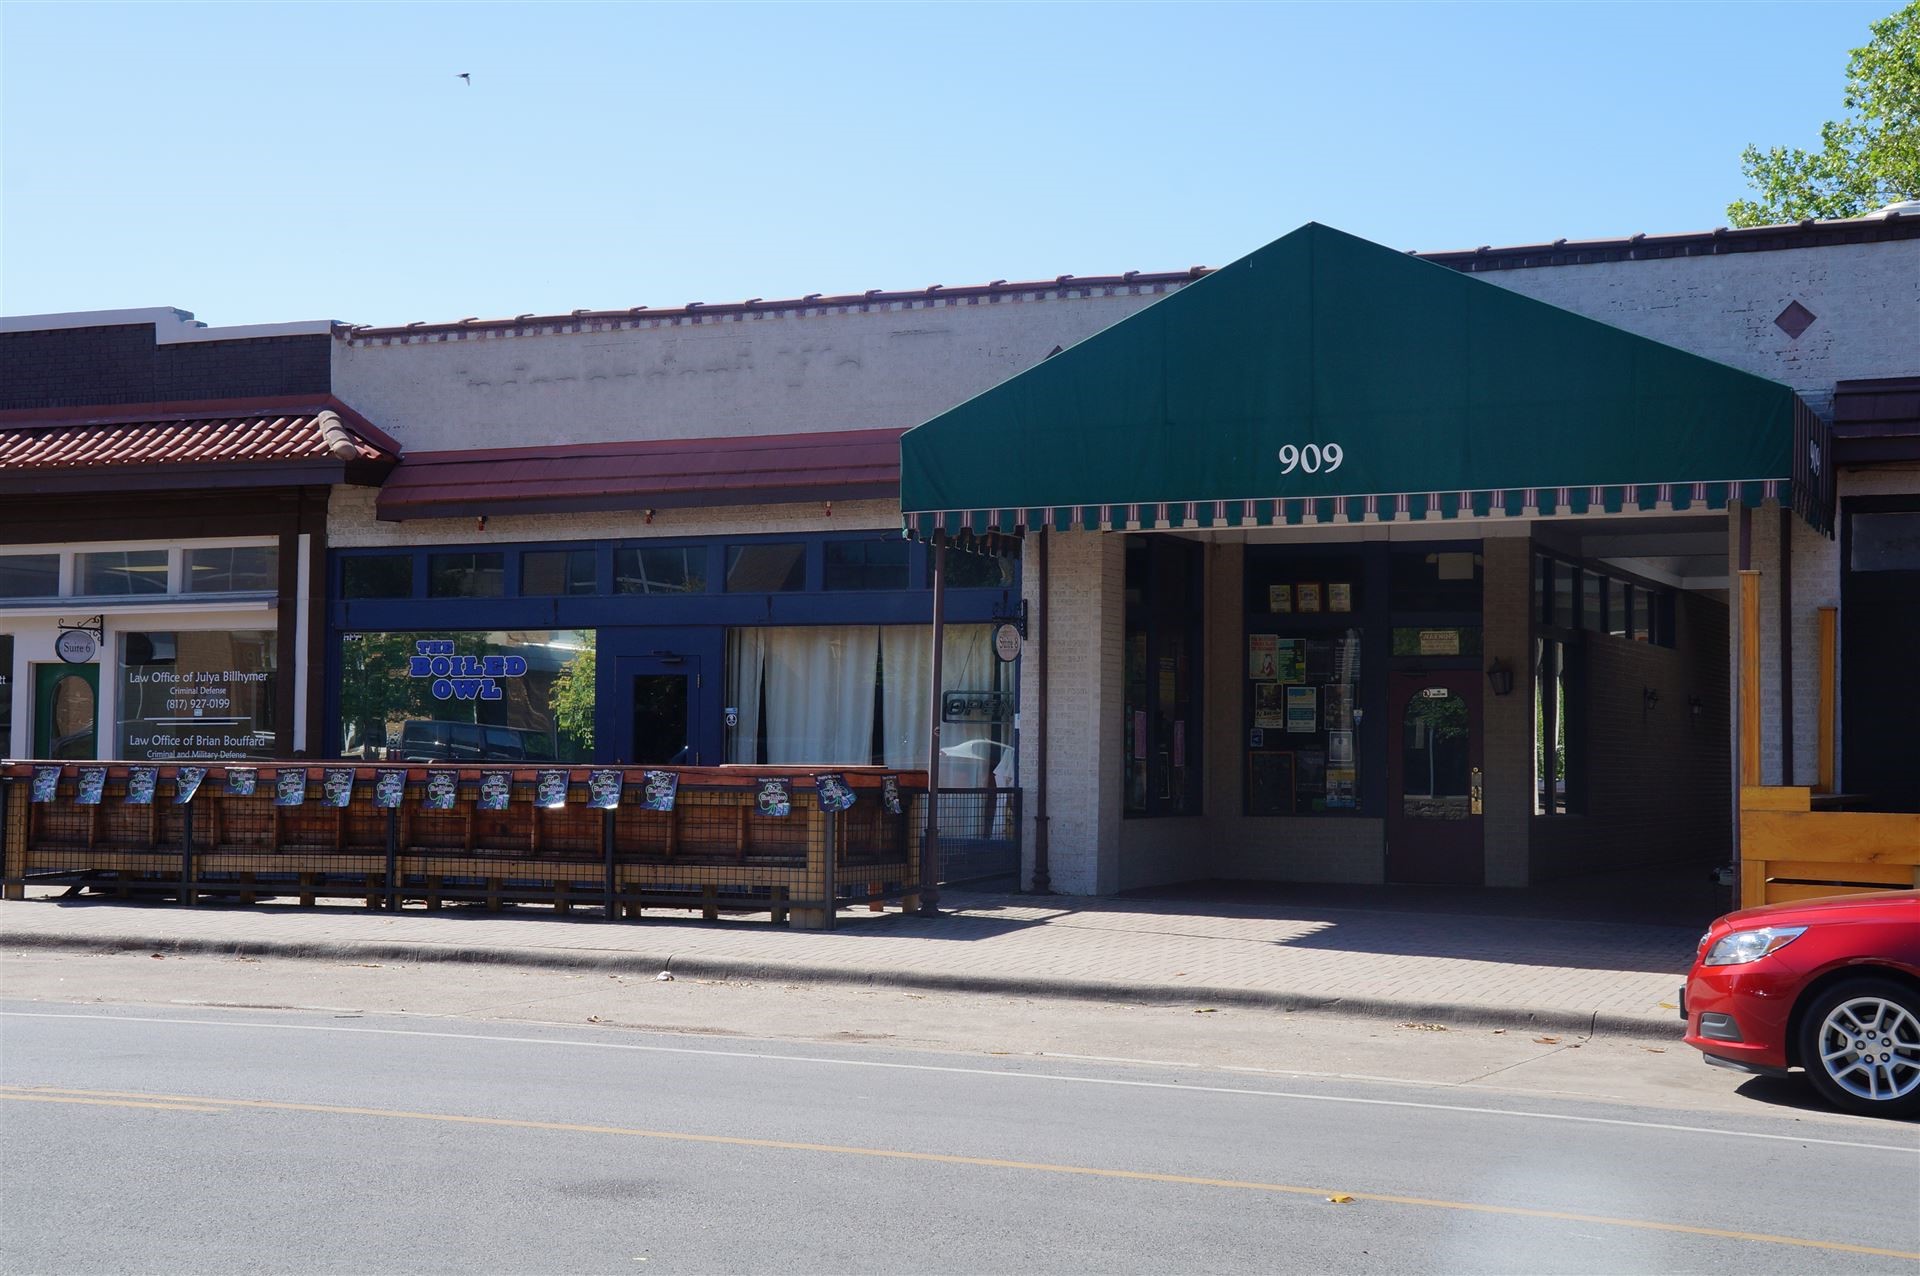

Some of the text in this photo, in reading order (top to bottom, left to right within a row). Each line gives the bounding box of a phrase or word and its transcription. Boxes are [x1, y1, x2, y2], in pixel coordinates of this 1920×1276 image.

[1279, 443, 1343, 474] 909
[63, 642, 91, 652] Suite 6
[416, 640, 454, 655] THE
[410, 656, 527, 678] BOILED
[129, 671, 268, 684] Law Office of Julya Billhymer
[170, 687, 226, 695] Criminal Defense
[432, 678, 502, 700] OWL
[166, 698, 230, 710] (817) 927-0199
[947, 698, 1014, 717] OPEN
[130, 735, 265, 746] Law Office of Brian Bouffard
[147, 750, 247, 760] Criminal and Military Defense
